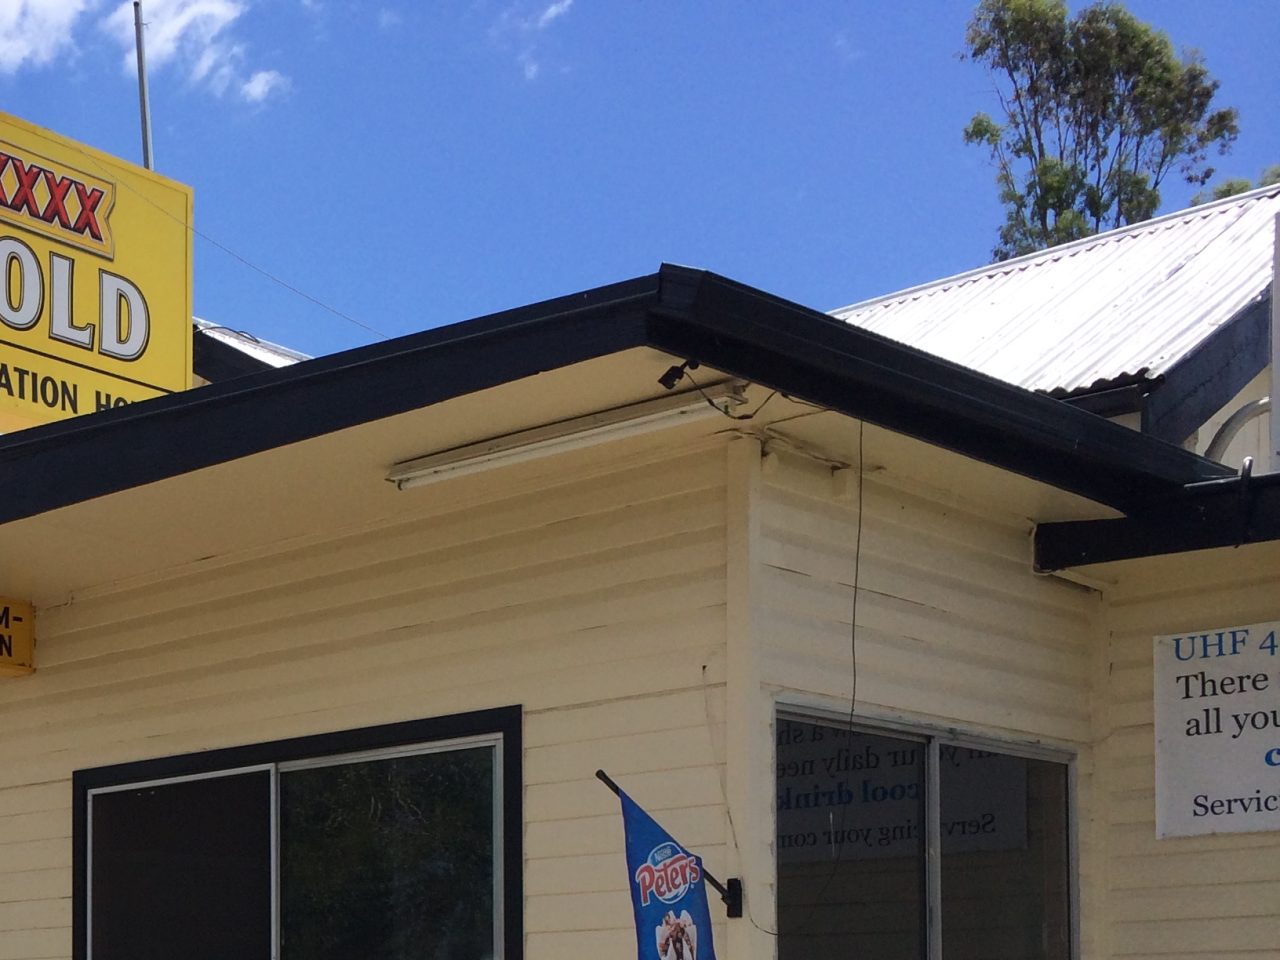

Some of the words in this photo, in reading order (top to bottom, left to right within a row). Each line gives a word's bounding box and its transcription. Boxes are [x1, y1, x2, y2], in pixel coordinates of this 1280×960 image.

[1172, 629, 1250, 661] UHF
[1176, 671, 1269, 700] There
[1185, 707, 1223, 737] all
[1193, 789, 1280, 817] Servic
[636, 853, 700, 906] Peters
